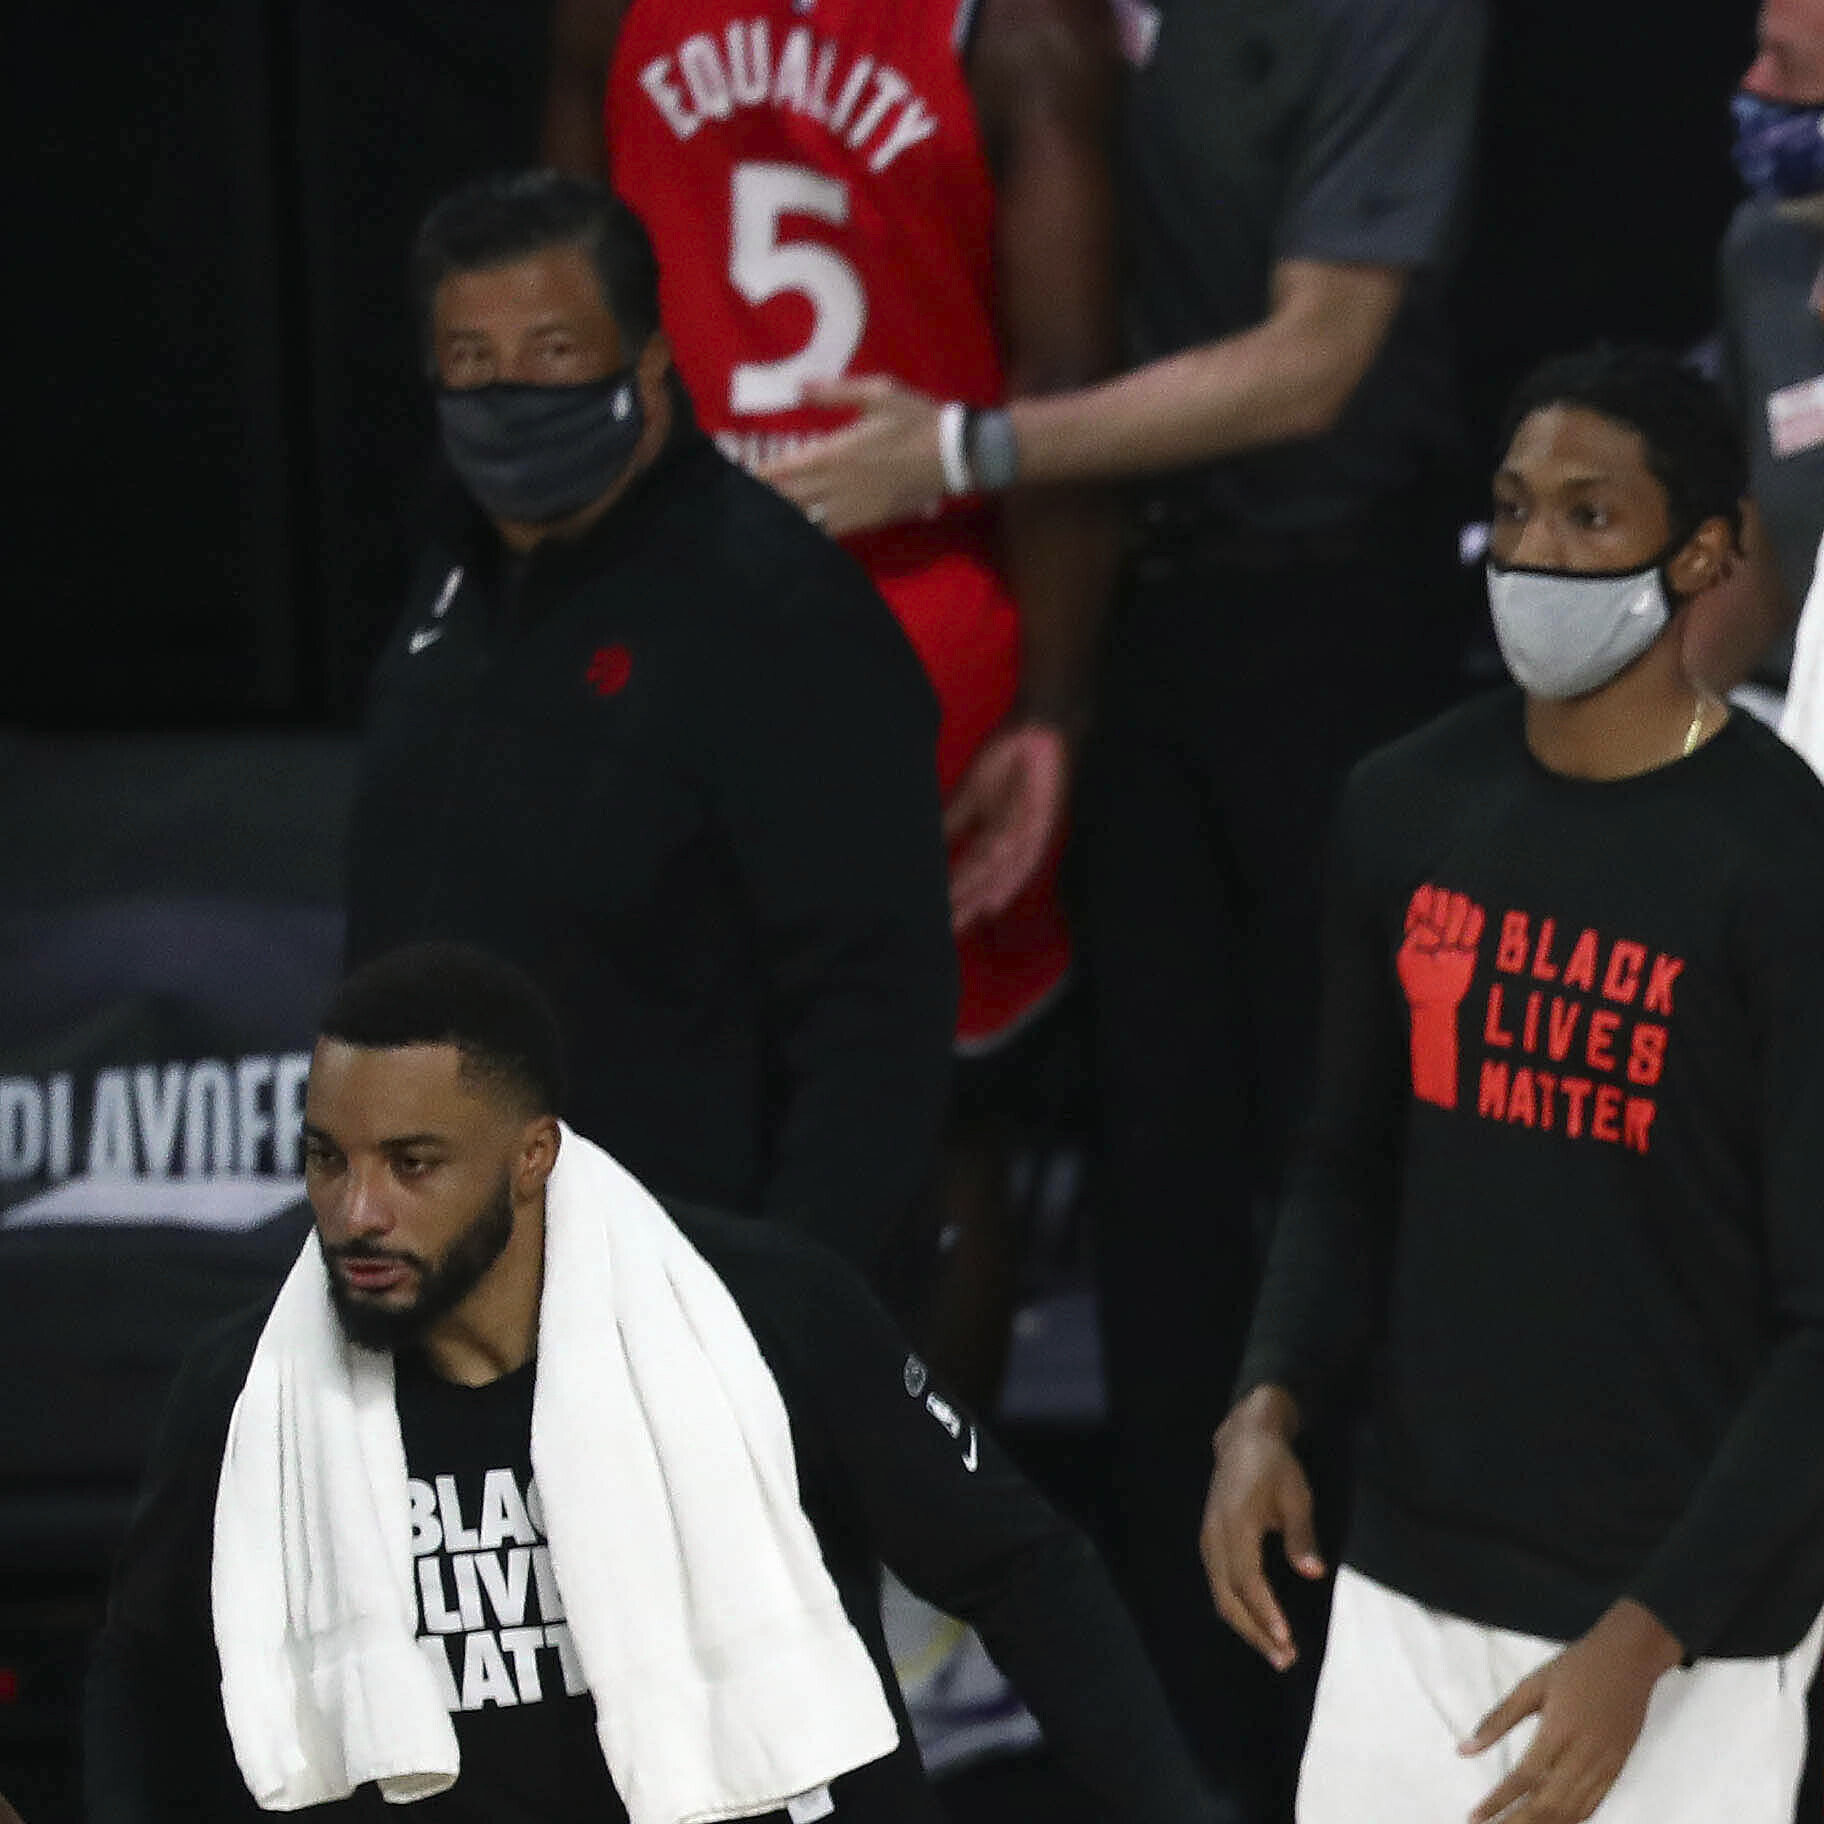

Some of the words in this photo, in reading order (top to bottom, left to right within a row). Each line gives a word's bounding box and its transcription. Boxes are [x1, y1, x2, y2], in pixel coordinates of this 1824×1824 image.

[639, 15, 939, 175] EQUALITY
[728, 160, 868, 416] 5
[1495, 908, 1685, 1016] BLACK
[1483, 983, 1668, 1086] LIVES
[1477, 1059, 1656, 1156] MATTER
